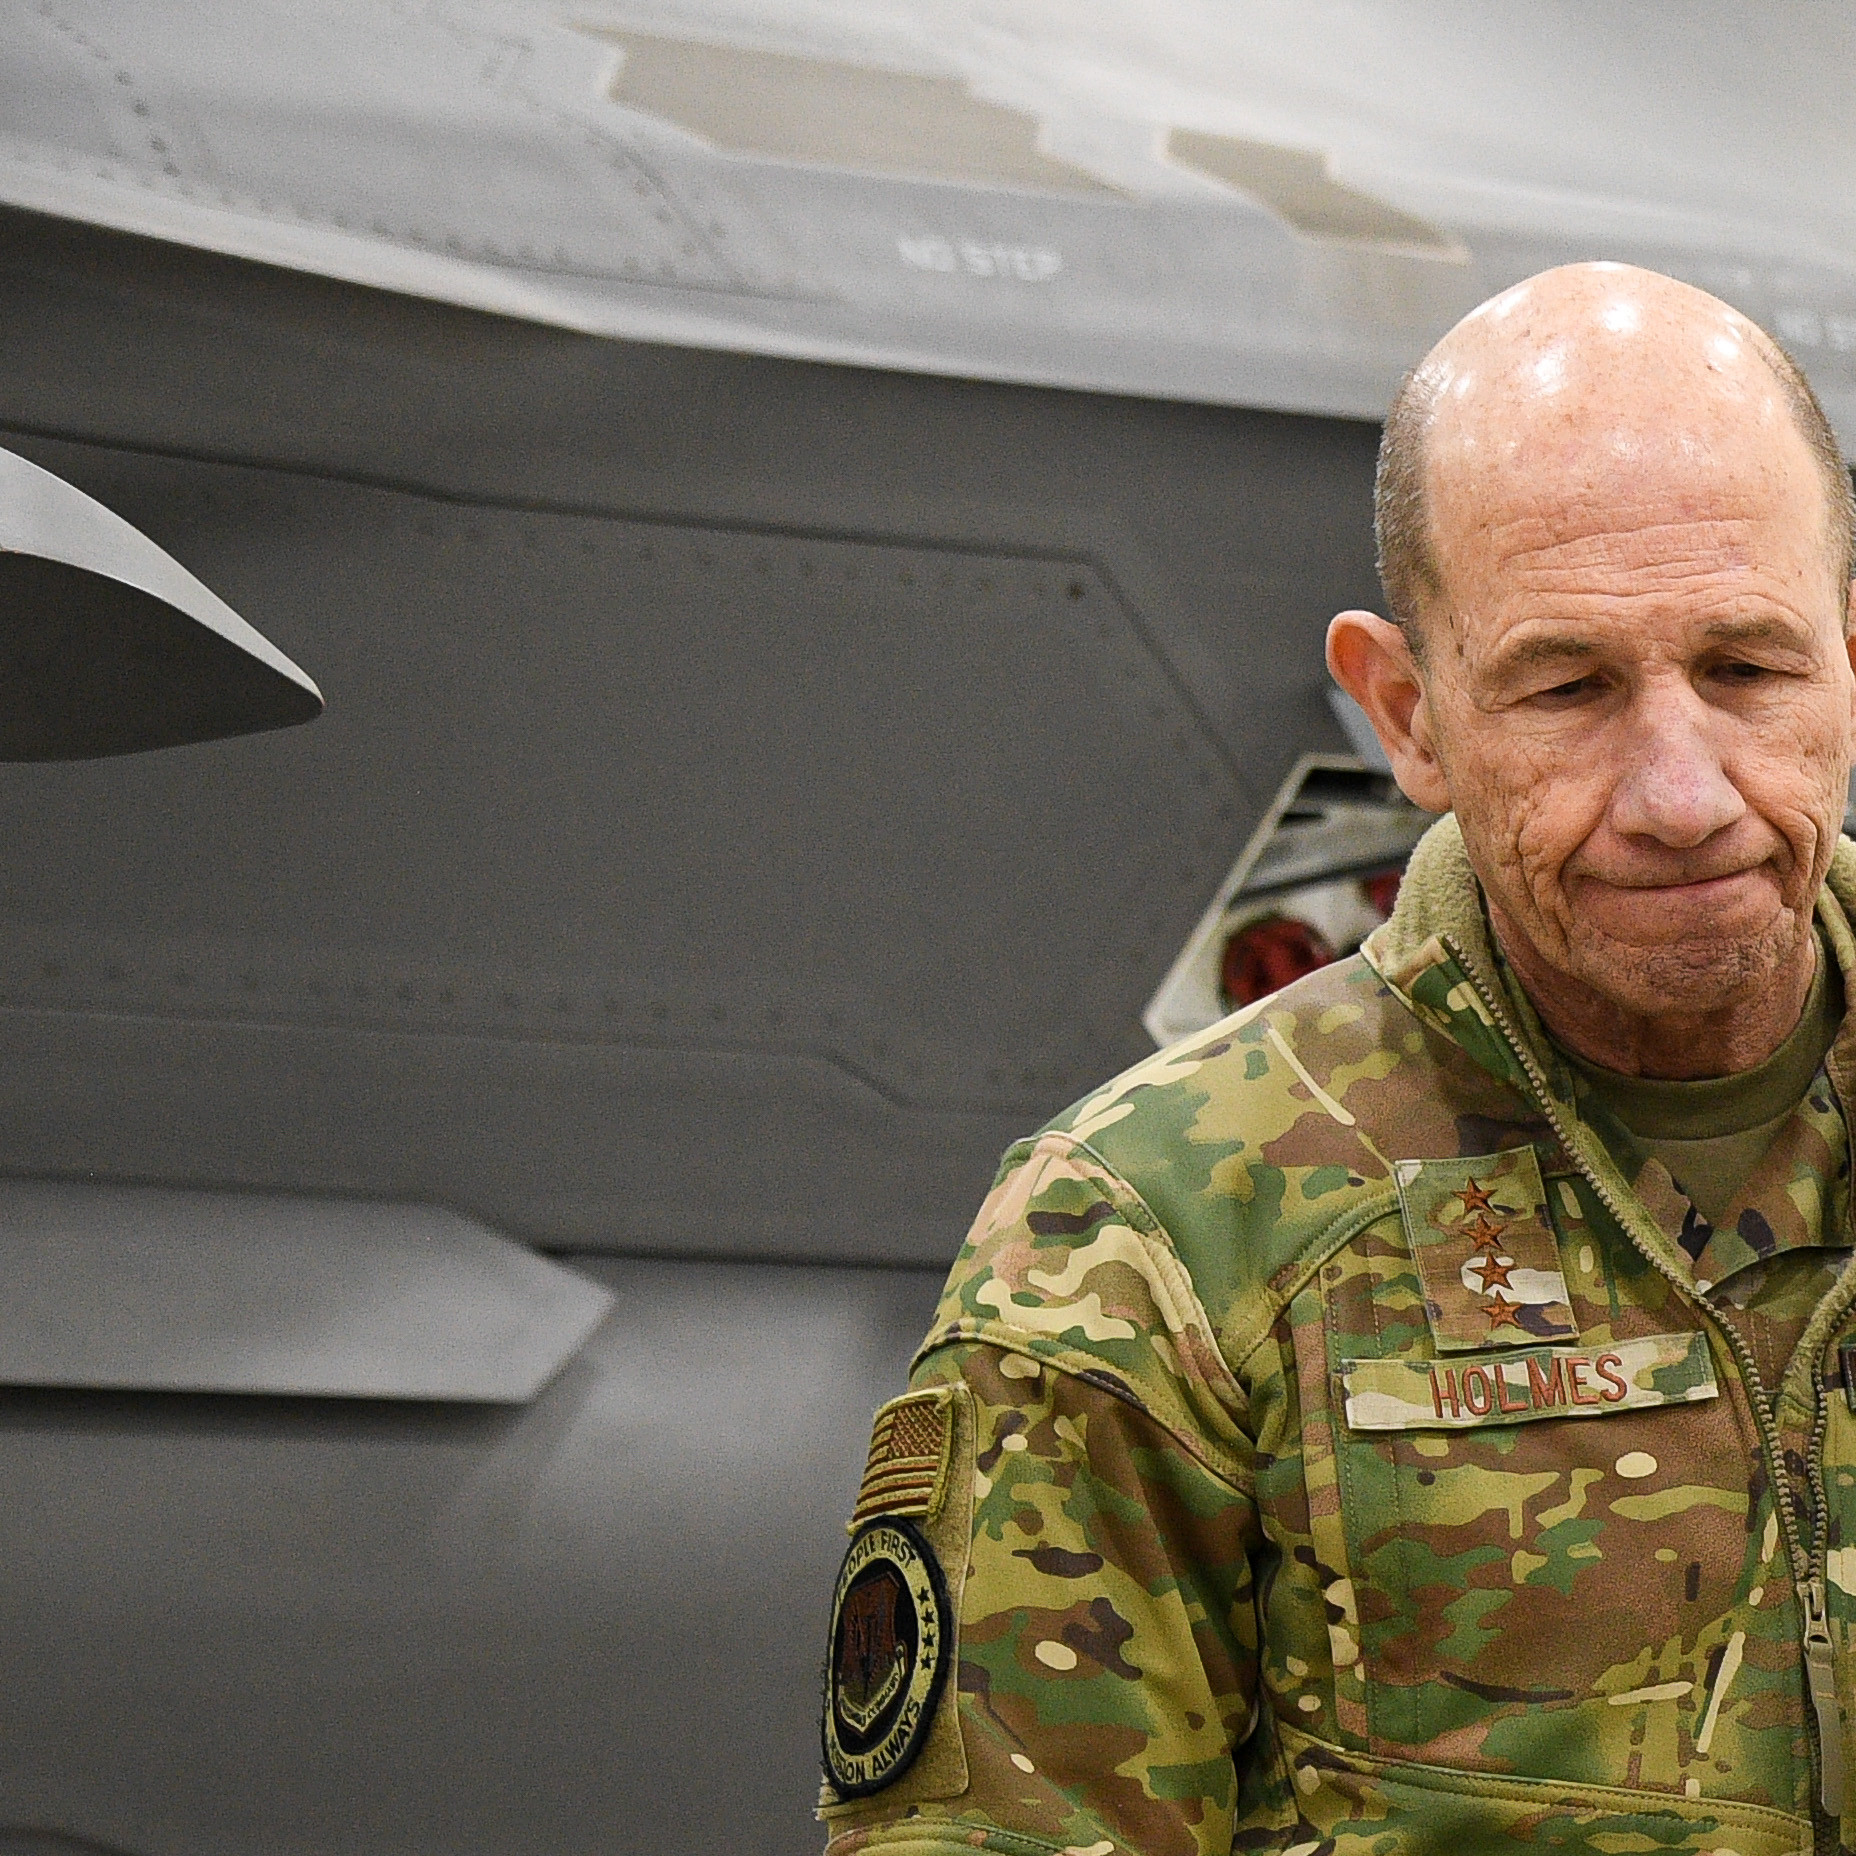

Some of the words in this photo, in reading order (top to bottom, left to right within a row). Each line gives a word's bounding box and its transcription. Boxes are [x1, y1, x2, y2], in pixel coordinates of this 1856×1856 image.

[1429, 1353, 1628, 1419] HOLMES
[880, 1529, 917, 1569] FIRST
[871, 1696, 921, 1778] ALWAYS
